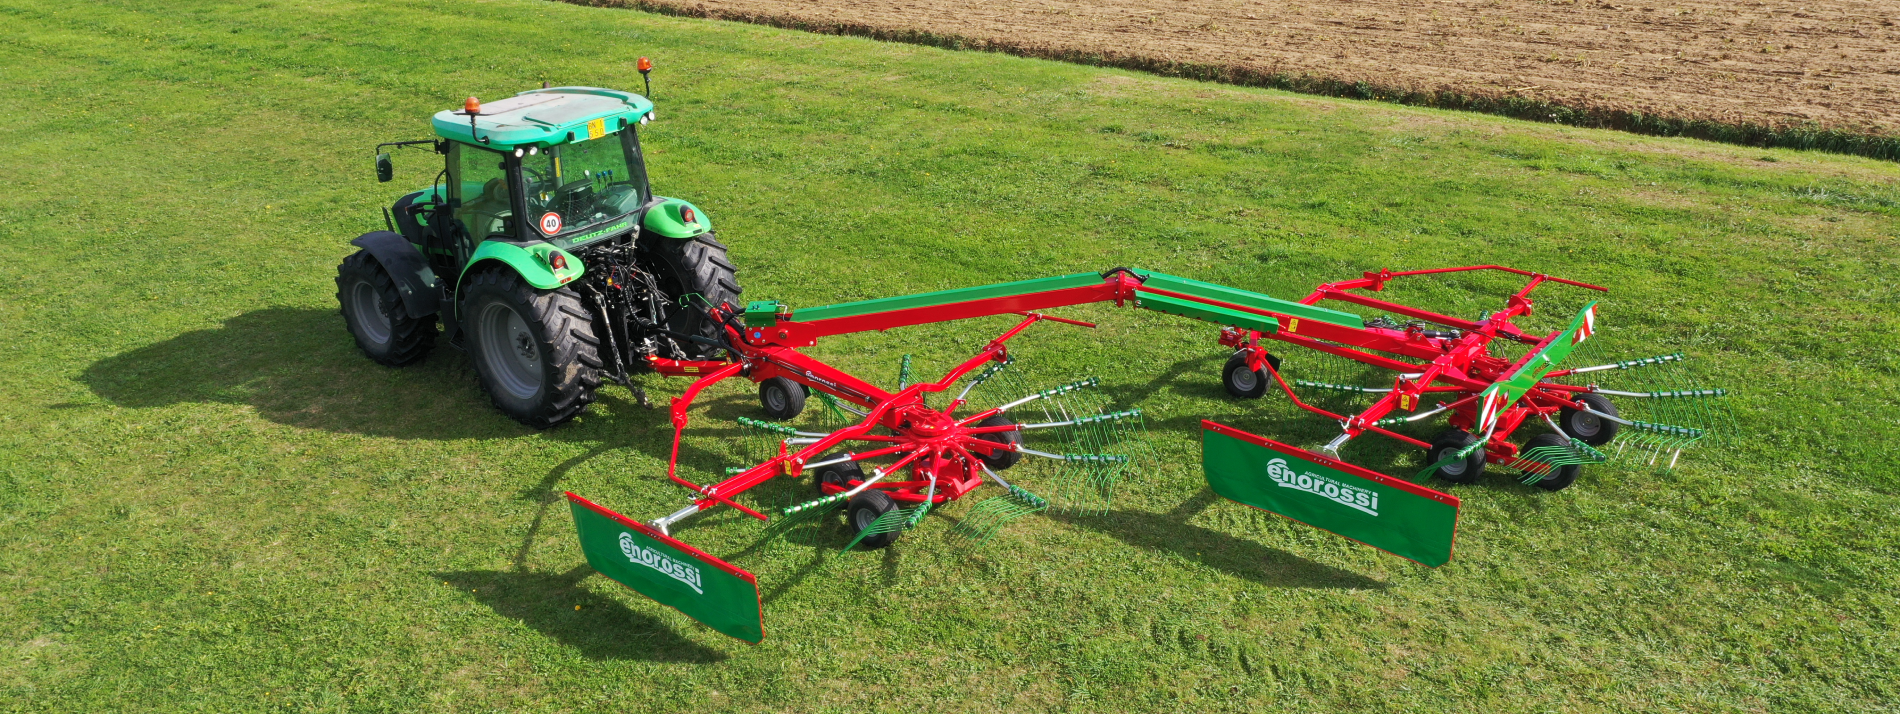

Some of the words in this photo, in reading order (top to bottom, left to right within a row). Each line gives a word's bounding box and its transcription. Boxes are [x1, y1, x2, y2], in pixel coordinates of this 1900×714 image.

[546, 219, 556, 228] 40
[572, 221, 628, 243] DEUTZ-FAHR
[1267, 460, 1378, 510] enorossi
[1305, 471, 1341, 486] AGRICULTURAL
[1342, 482, 1372, 495] MACHINERY
[619, 535, 702, 588] enorossi
